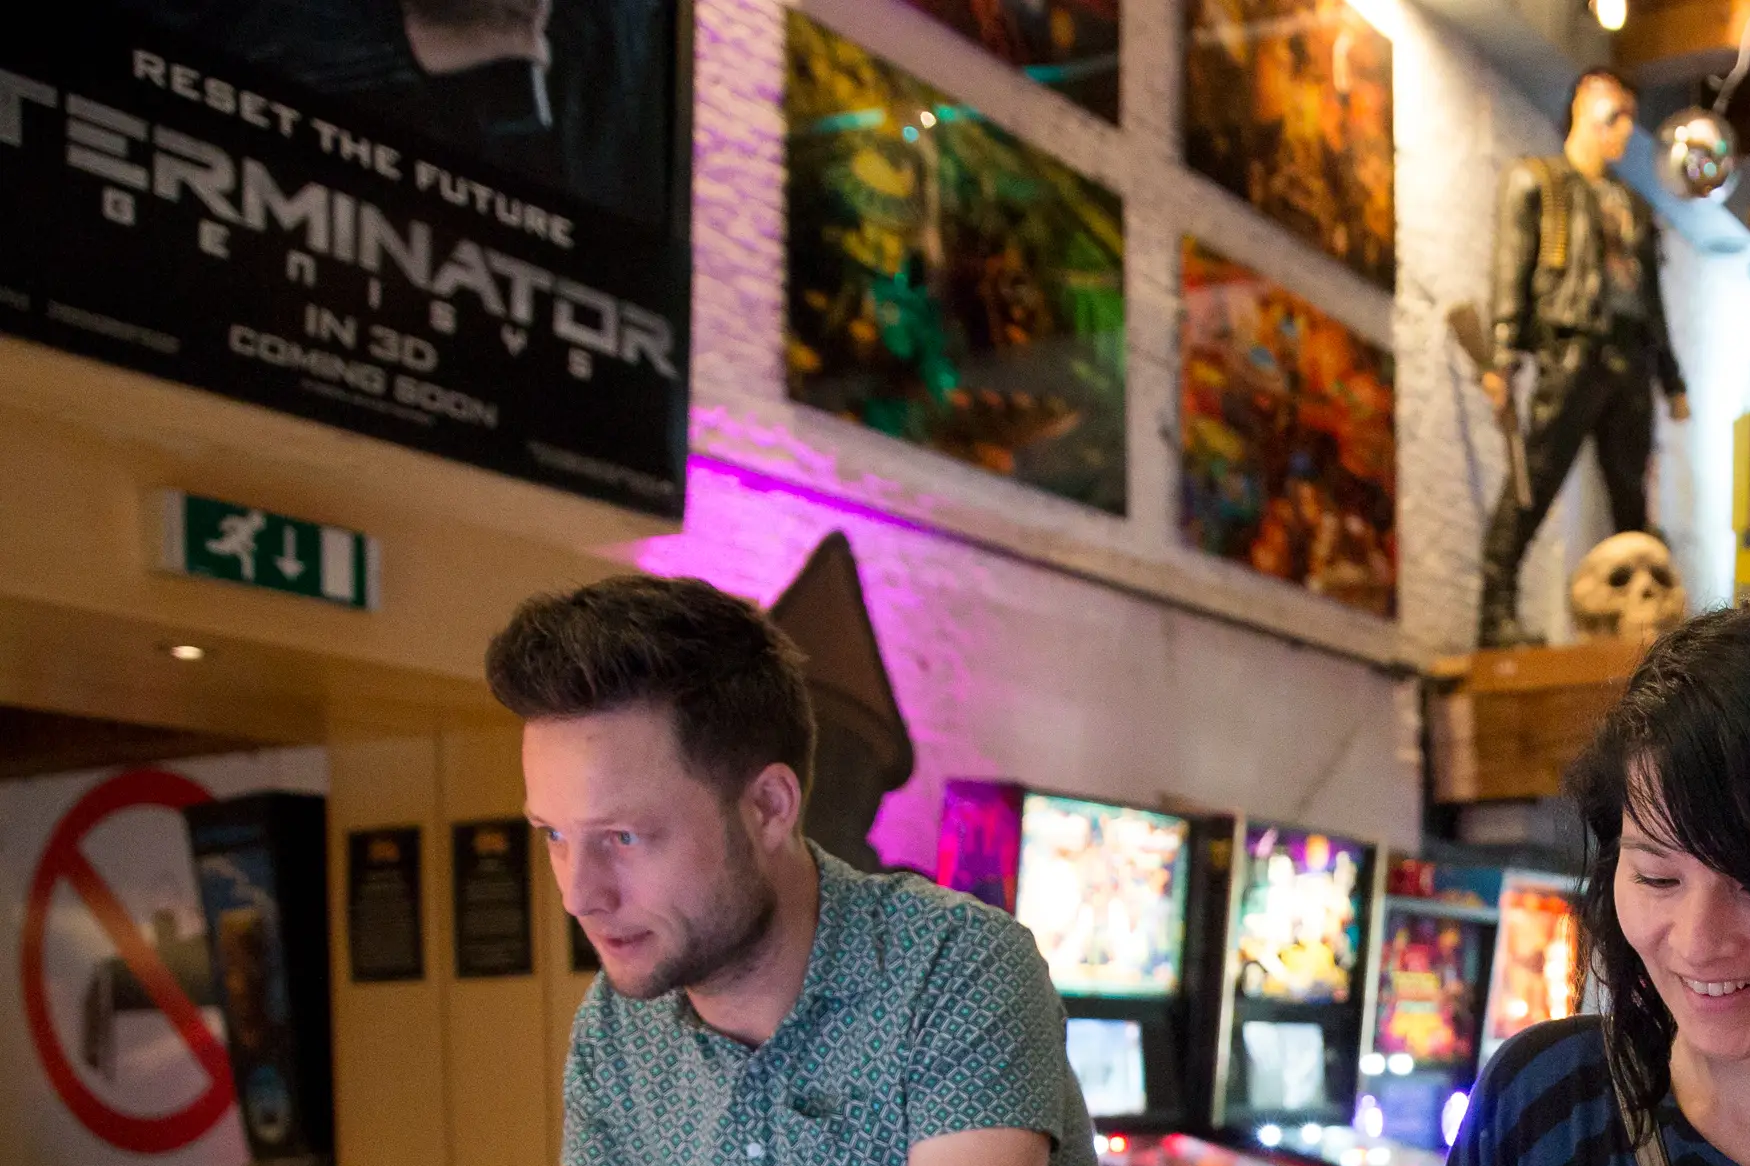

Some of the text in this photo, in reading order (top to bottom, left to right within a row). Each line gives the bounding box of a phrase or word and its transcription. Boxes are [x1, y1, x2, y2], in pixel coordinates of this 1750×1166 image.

[133, 49, 576, 249] RESET THE FUTURE
[227, 324, 388, 399] COMING
[392, 376, 500, 428] SOON
[303, 303, 440, 374] IN 3D
